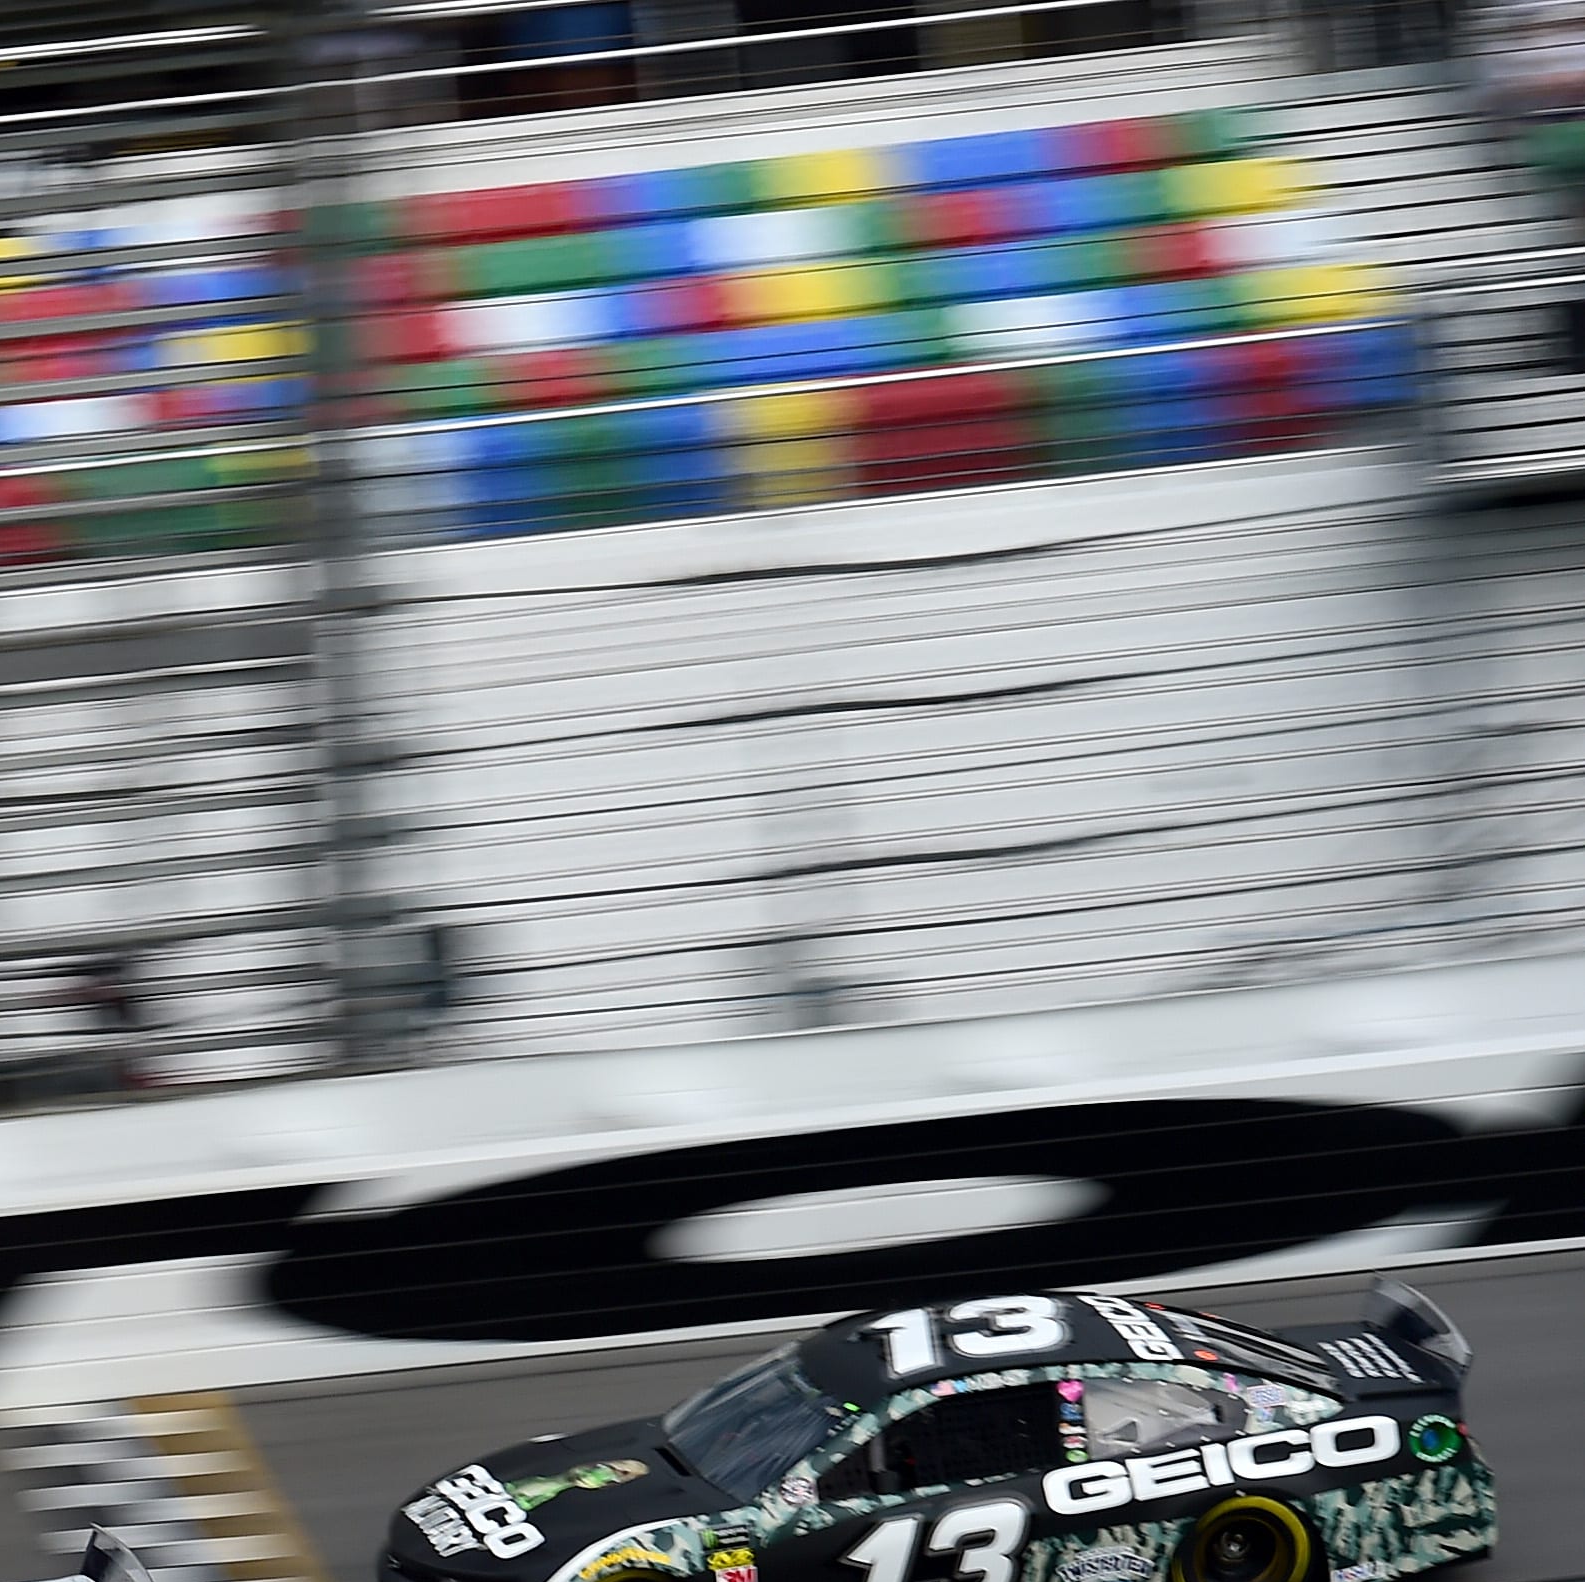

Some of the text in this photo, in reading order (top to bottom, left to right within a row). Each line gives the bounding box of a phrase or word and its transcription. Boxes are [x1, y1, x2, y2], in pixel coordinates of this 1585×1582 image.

[867, 1294, 1065, 1378] 13
[435, 1464, 546, 1559] GEICO
[1042, 1415, 1401, 1515] GEICO
